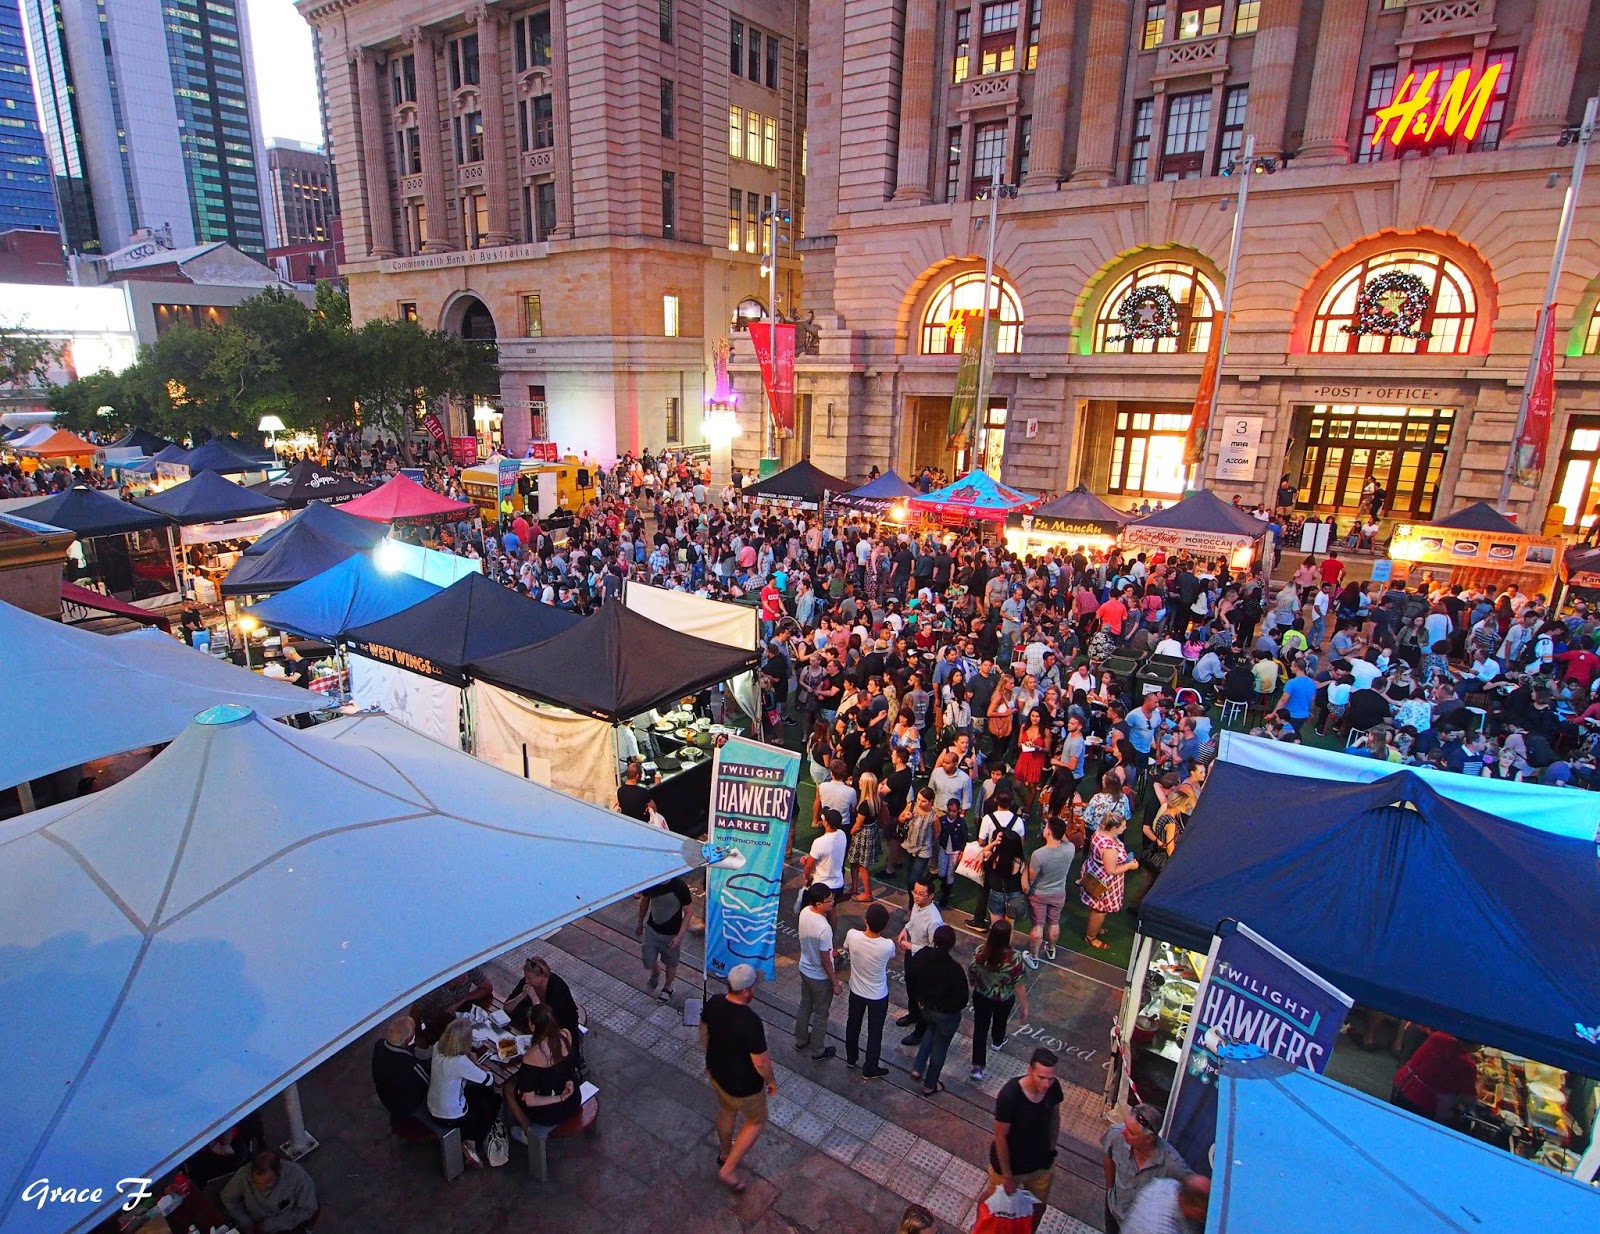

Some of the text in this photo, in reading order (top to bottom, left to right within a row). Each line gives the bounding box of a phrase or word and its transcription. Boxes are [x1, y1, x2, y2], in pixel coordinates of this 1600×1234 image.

[1371, 62, 1503, 146] H&M
[392, 249, 530, 271] Commonwealth Bank of Australia
[1320, 387, 1433, 400] POST OFFICE
[422, 414, 443, 438] SALE!
[1236, 421, 1248, 434] 3
[832, 494, 895, 510] Los Amigos
[1034, 518, 1048, 529] Fu
[1051, 520, 1102, 534] Manchu
[1185, 537, 1233, 547] MOROCCAN
[368, 642, 394, 662] WEST
[394, 649, 432, 674] WINGS
[721, 764, 782, 780] TWILIGHT
[718, 781, 791, 820] HAWKERS
[717, 818, 768, 832] MARKET
[716, 835, 771, 847] VISITPERTHCITY.COM
[1218, 963, 1310, 1020] TWILIGHT
[1203, 985, 1324, 1073] HAWKERS
[1012, 1023, 1097, 1062] played
